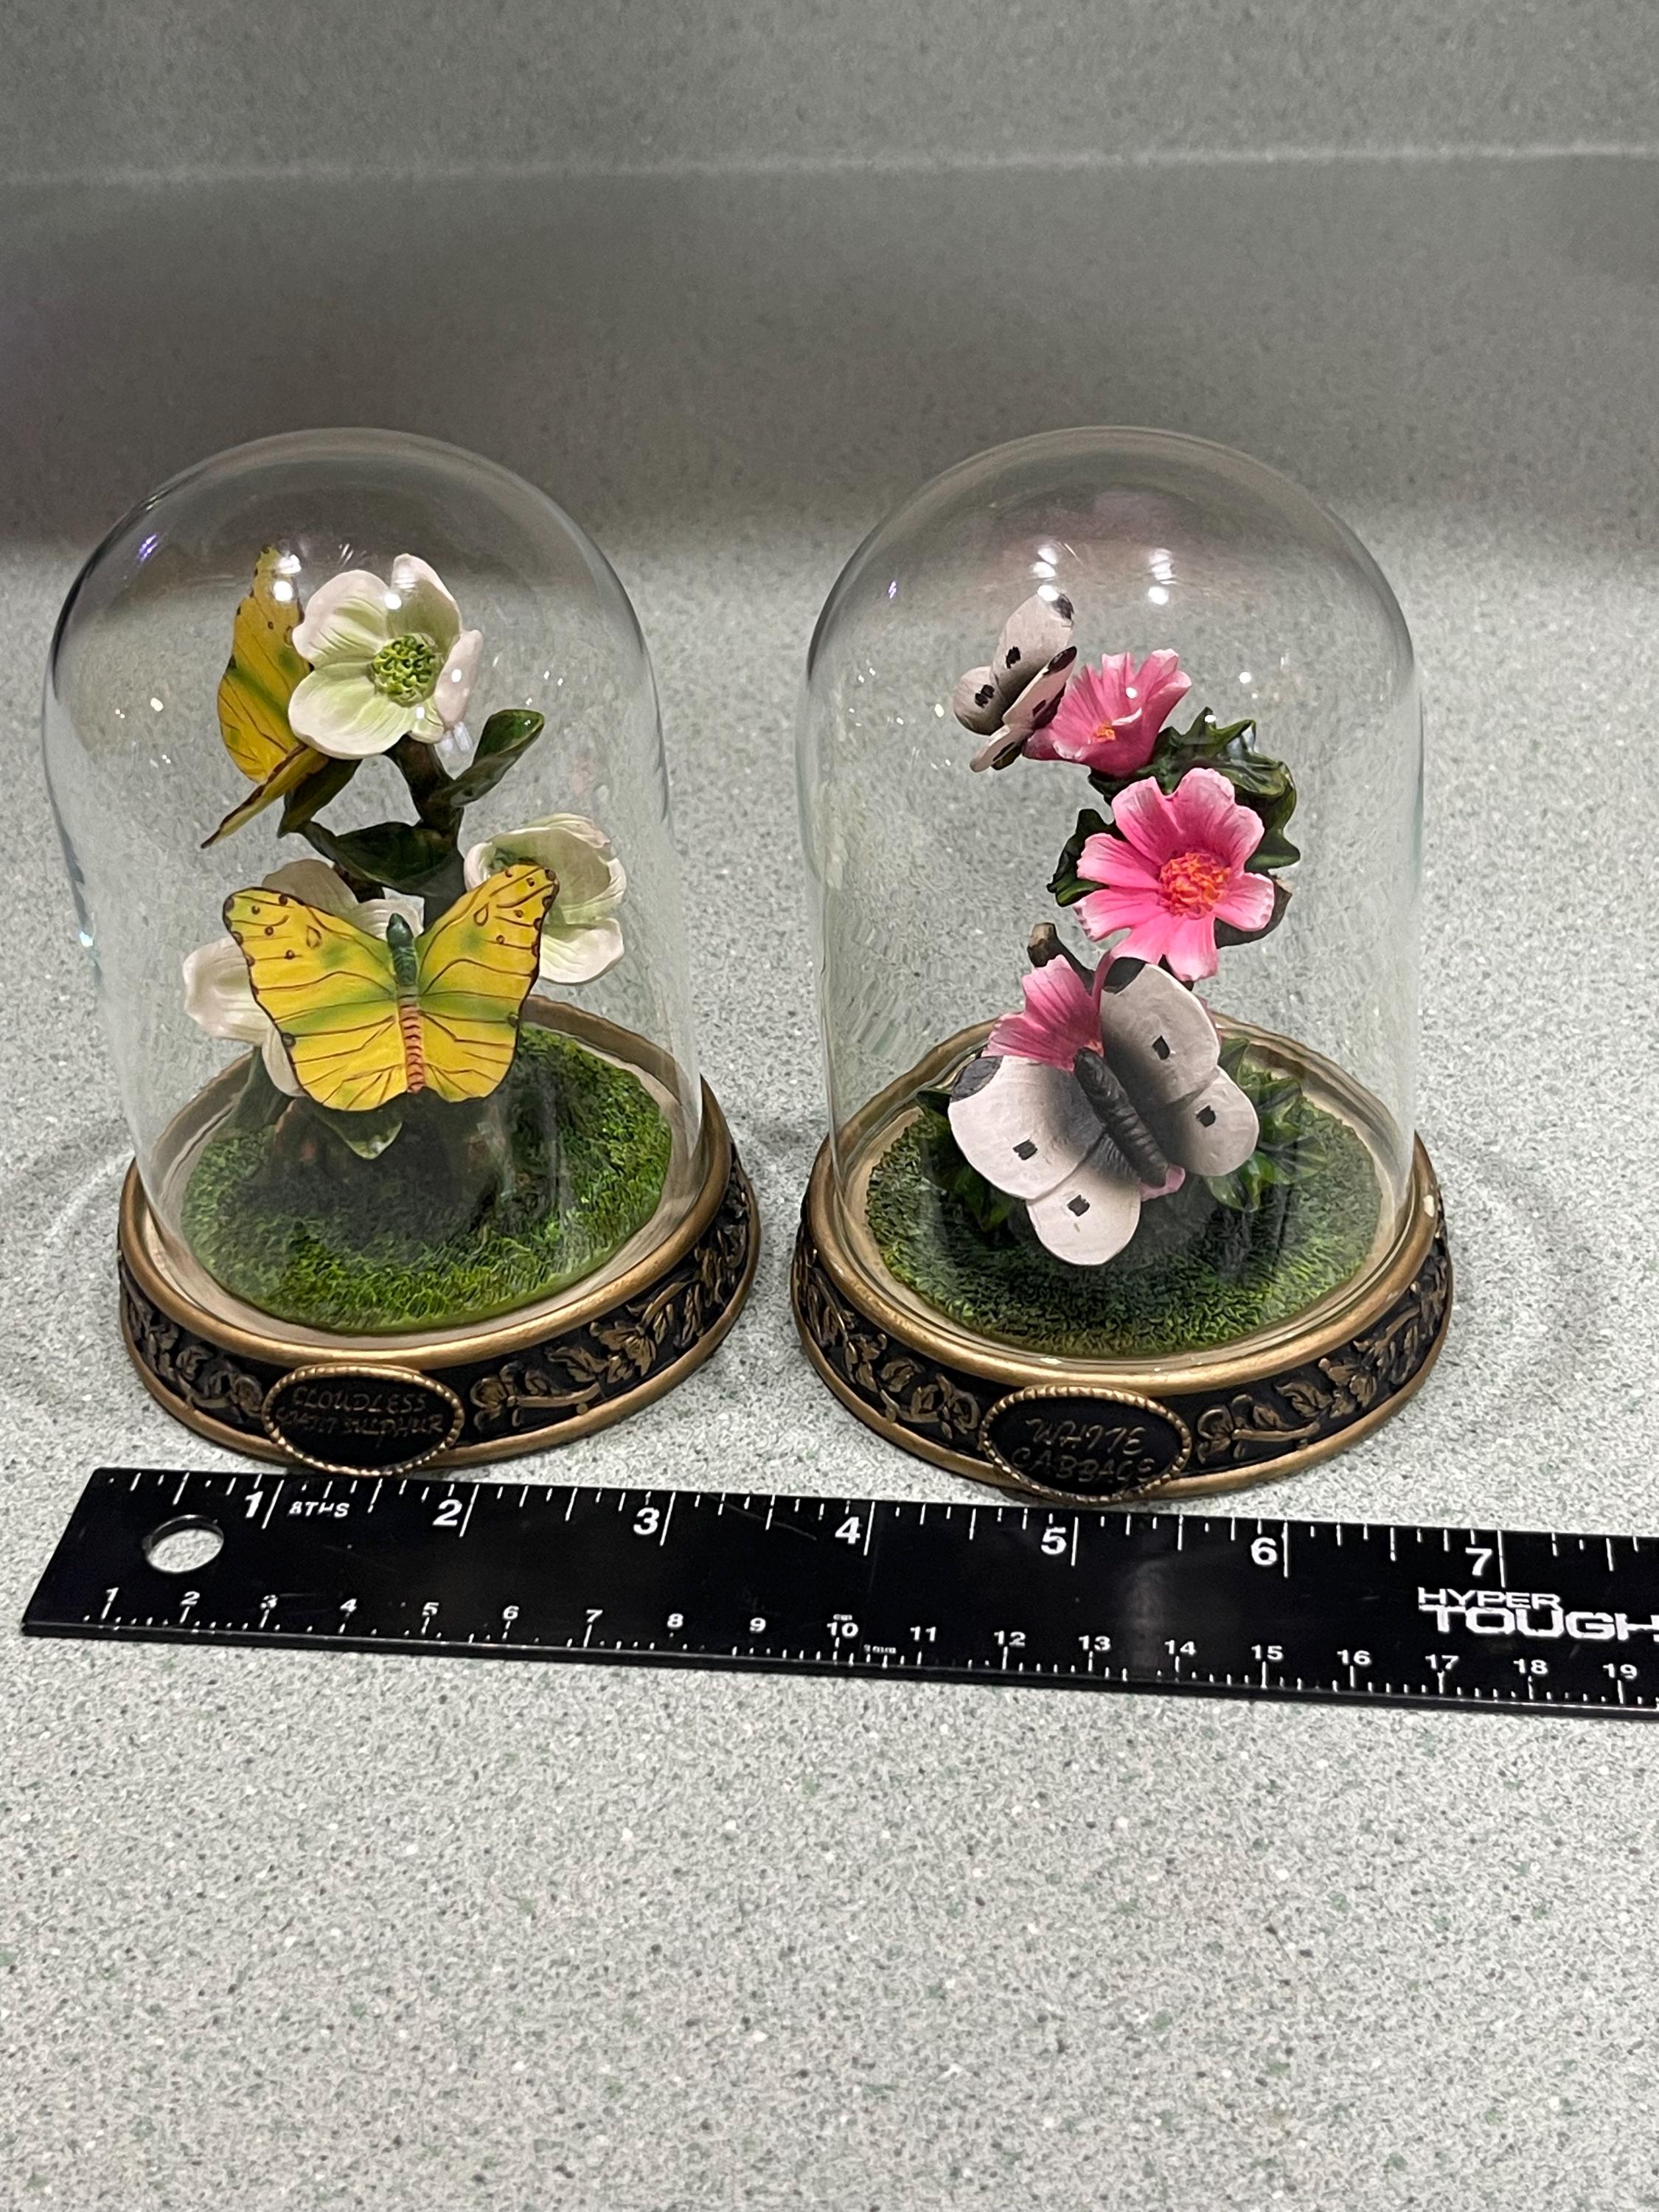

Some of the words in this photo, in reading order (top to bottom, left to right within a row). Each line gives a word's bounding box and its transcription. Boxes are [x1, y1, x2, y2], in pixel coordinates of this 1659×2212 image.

[292, 1385, 426, 1414] CLOUDLESS
[1025, 1417, 1147, 1456] WHITE
[1011, 1445, 1156, 1485] CABBAGE
[245, 1491, 264, 1518] 1
[432, 1499, 463, 1529] 2
[633, 1507, 660, 1535] 3
[835, 1517, 860, 1545] 4
[1040, 1526, 1067, 1555] 5
[1251, 1537, 1278, 1566] 6
[1465, 1547, 1493, 1576] 7
[1417, 1586, 1562, 1610] HYPER
[106, 1587, 119, 1602] 1
[181, 1590, 201, 1605] 2
[260, 1594, 278, 1609] 3
[340, 1598, 357, 1613] 4
[422, 1601, 439, 1616] 5
[503, 1605, 520, 1622] 6
[586, 1609, 603, 1623] 7
[667, 1613, 684, 1628] 8
[749, 1617, 766, 1632] 9
[827, 1621, 859, 1640] 10
[910, 1626, 936, 1642] 11
[994, 1630, 1026, 1646] 12
[1078, 1635, 1111, 1652] 13
[1164, 1639, 1197, 1656] 14
[1251, 1644, 1283, 1661] 15
[1337, 1649, 1371, 1666] 16
[1425, 1654, 1459, 1670] 17
[1513, 1658, 1548, 1675] 18
[1602, 1663, 1638, 1680] 19
[1418, 1604, 1659, 1642] TOUGH
